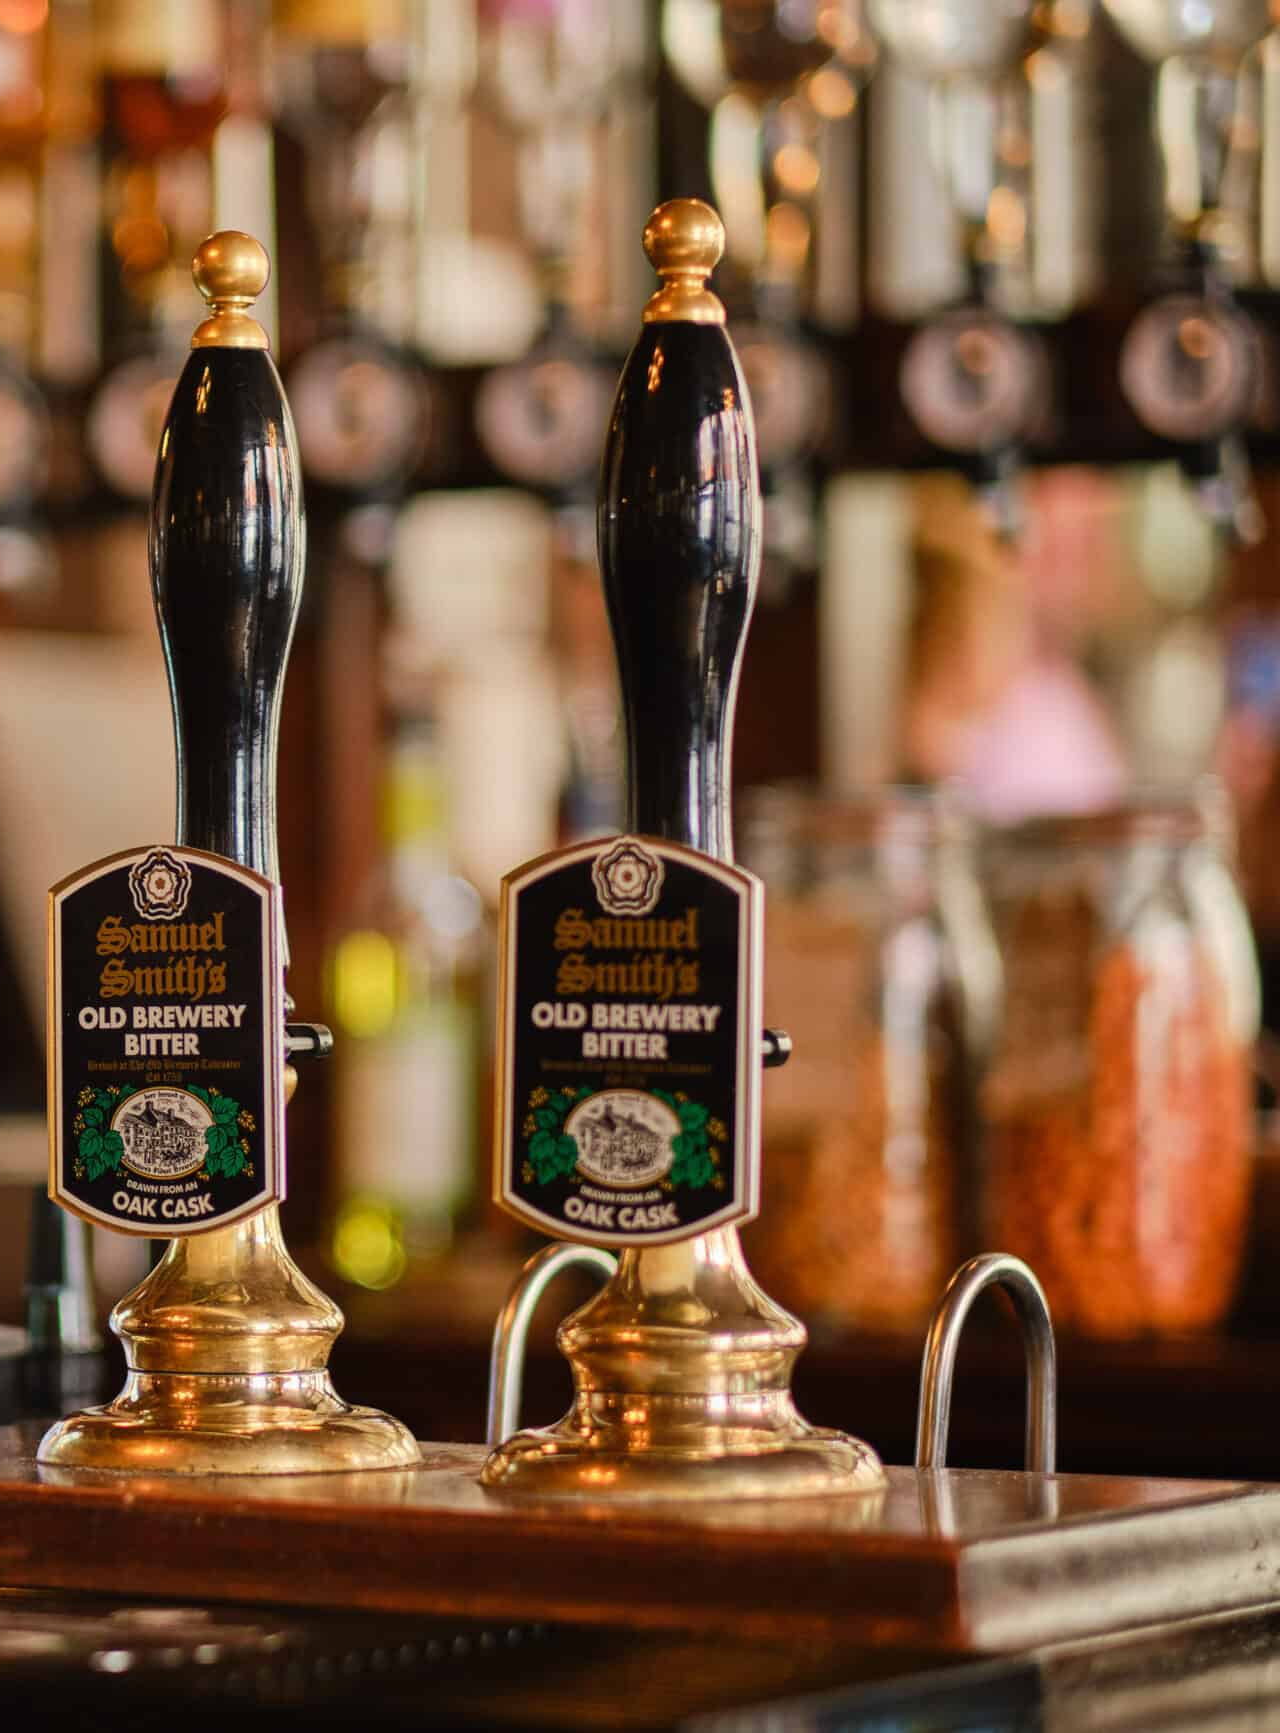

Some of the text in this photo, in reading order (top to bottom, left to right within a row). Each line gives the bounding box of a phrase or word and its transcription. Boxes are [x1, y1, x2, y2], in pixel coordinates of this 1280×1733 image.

[96, 912, 225, 955] Samuel
[554, 907, 699, 950] Samuel
[100, 956, 226, 1002] Smith's
[557, 953, 699, 1001] Smith's
[78, 1004, 247, 1030] OLD BREWERY
[531, 1002, 721, 1031] OLD BREWERY
[124, 1033, 200, 1056] BITTER
[582, 1032, 668, 1059] BITTER
[126, 1180, 198, 1194] DRAWN FROM AN
[112, 1191, 215, 1219] OAK CASK
[563, 1197, 680, 1230] OAK CASK
